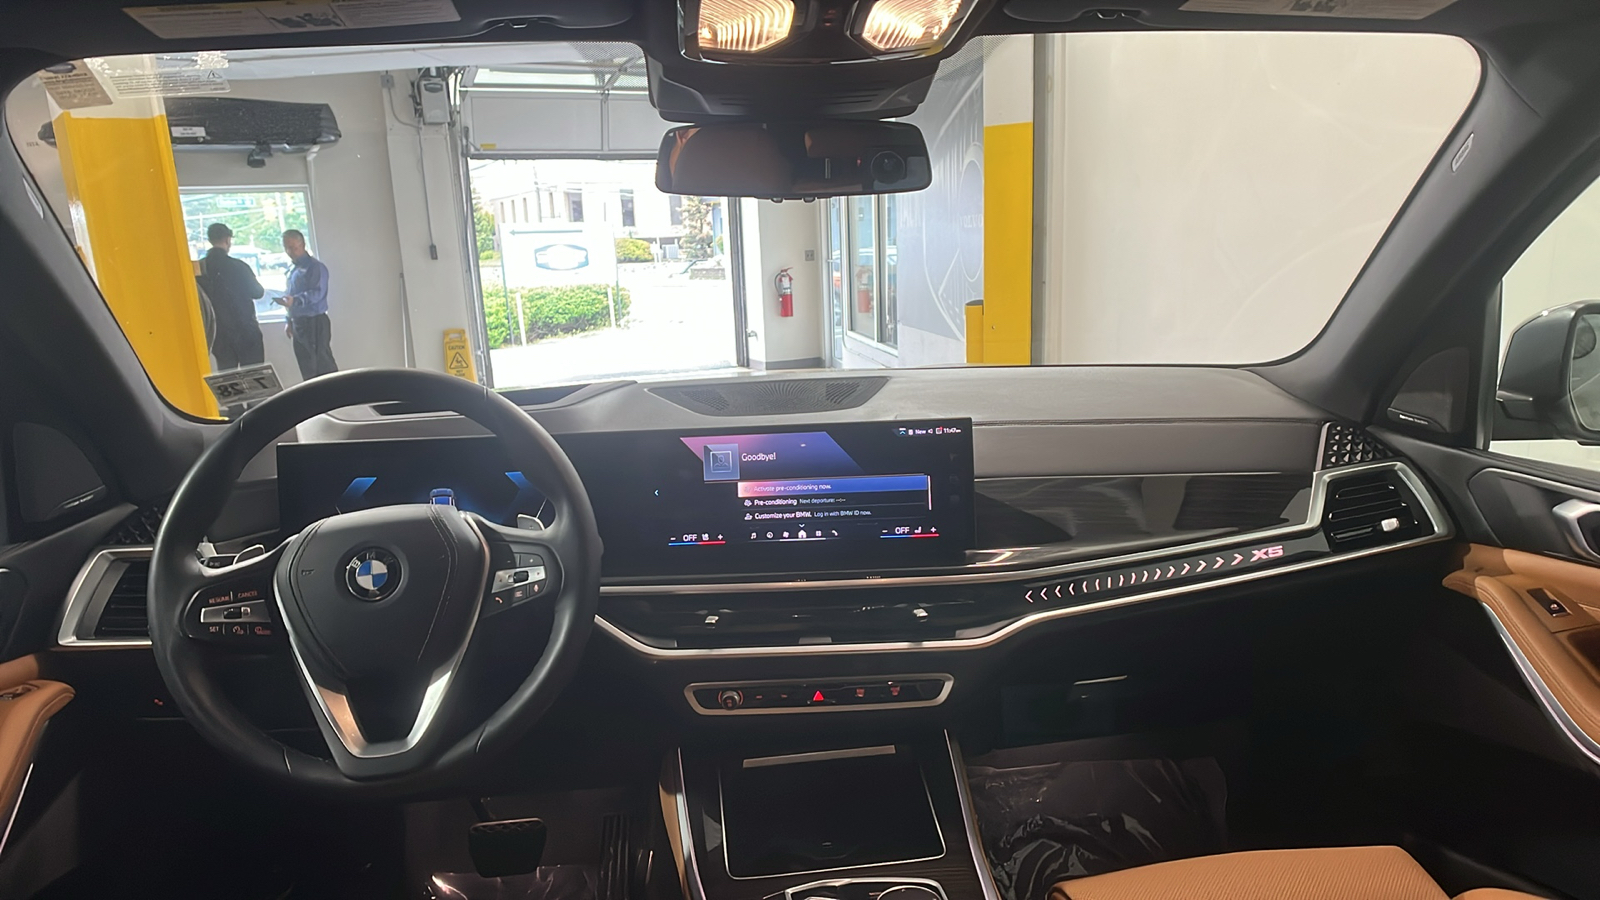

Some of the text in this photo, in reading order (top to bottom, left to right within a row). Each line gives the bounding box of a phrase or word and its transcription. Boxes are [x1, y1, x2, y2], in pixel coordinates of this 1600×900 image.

[741, 452, 776, 462] Goodbye!
[775, 484, 818, 492] pre-conditioning
[754, 512, 783, 520] Customize
[782, 512, 796, 520] your
[895, 526, 910, 534] OFF
[1250, 545, 1284, 562] X5
[237, 590, 258, 599] CANCEL
